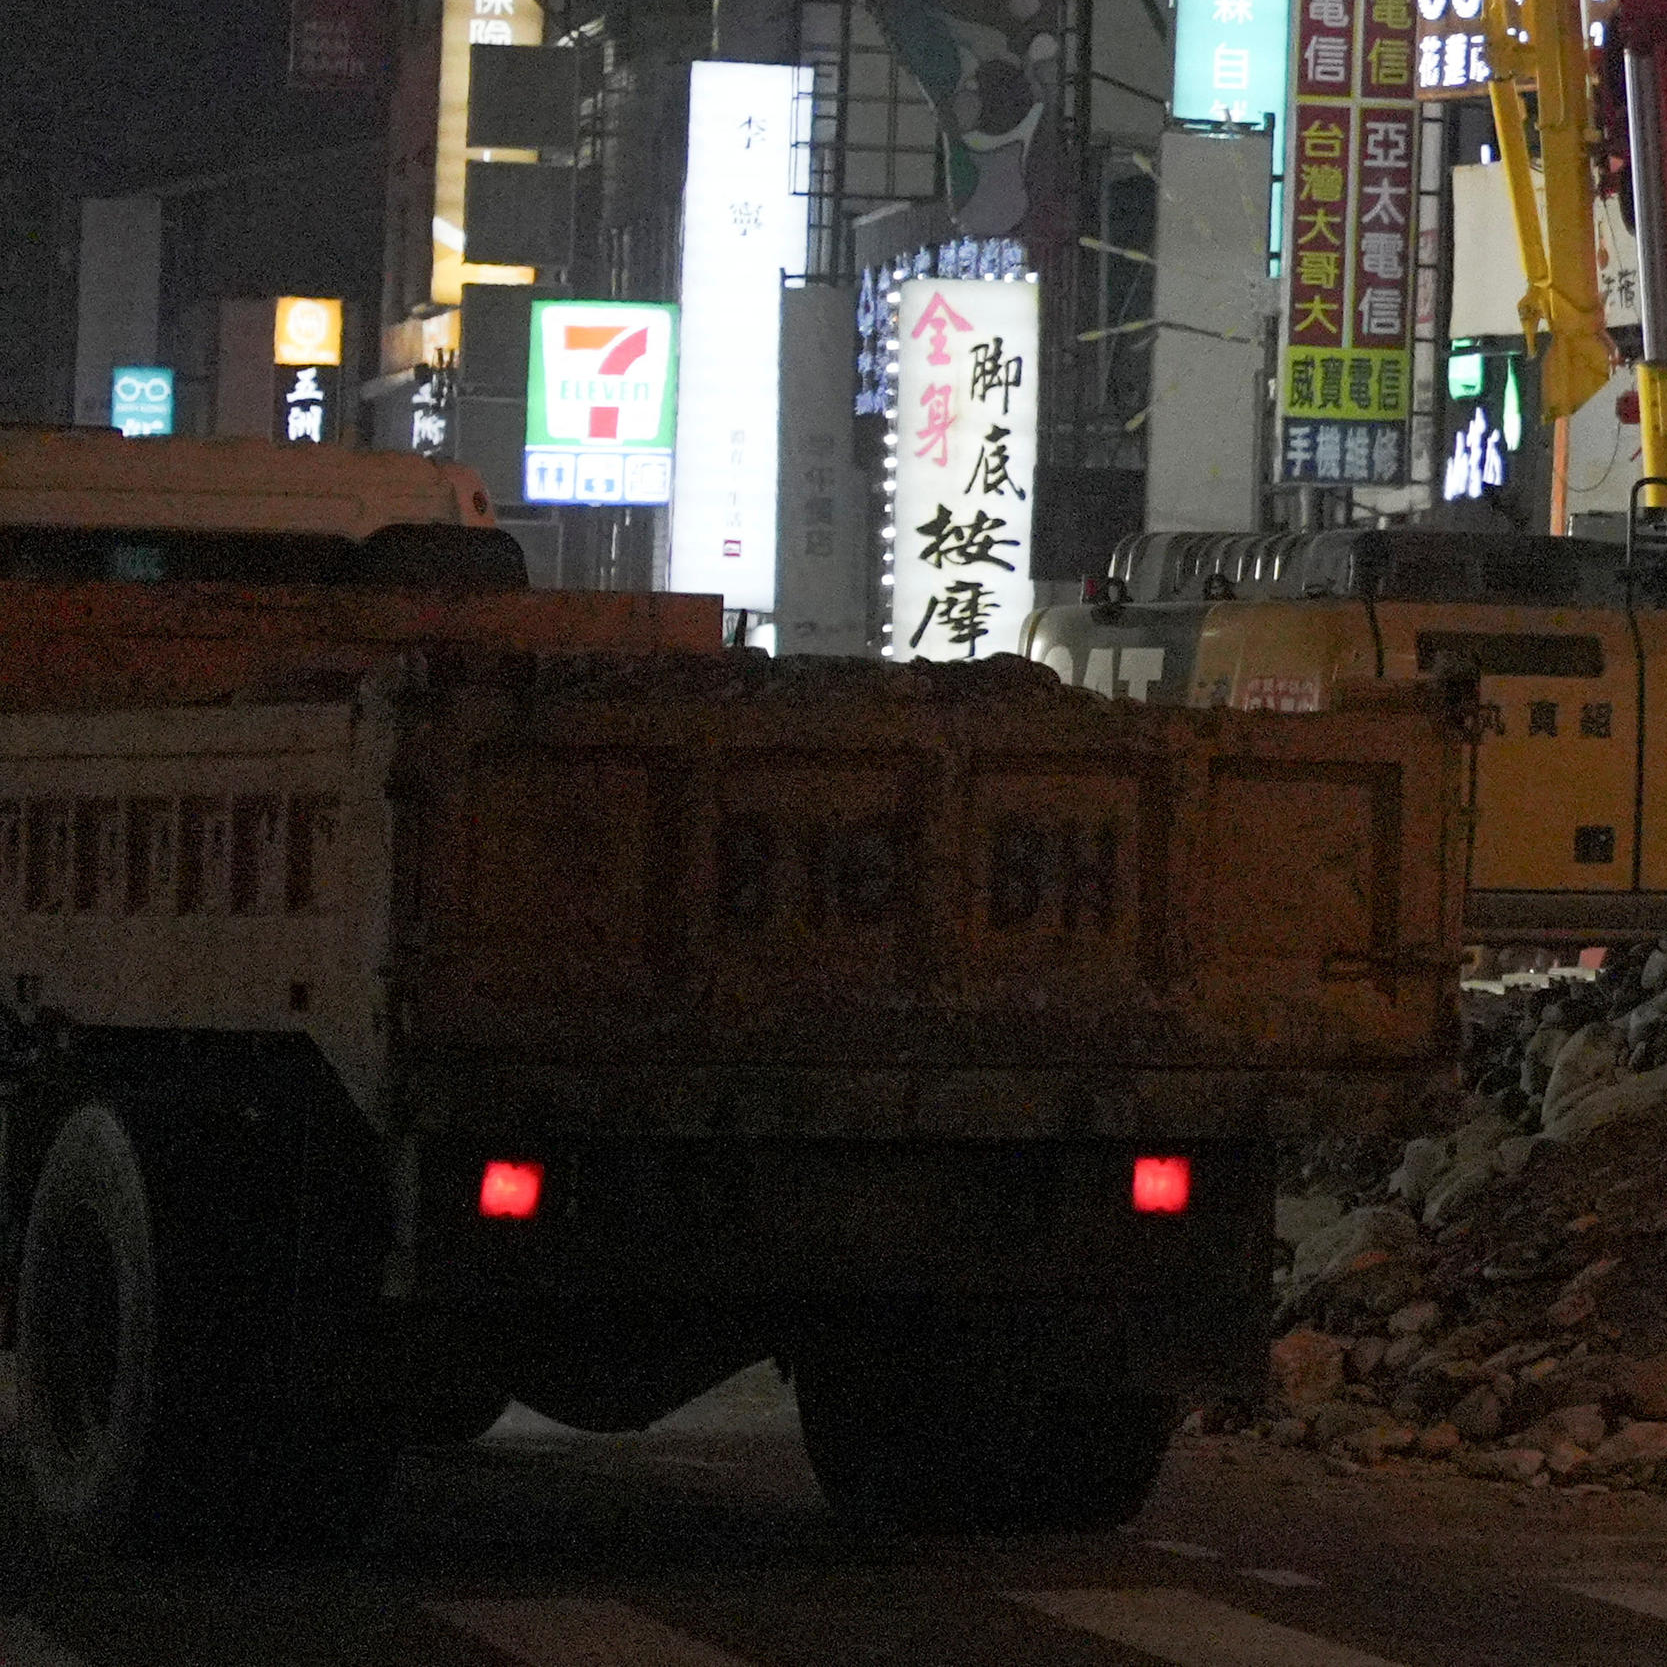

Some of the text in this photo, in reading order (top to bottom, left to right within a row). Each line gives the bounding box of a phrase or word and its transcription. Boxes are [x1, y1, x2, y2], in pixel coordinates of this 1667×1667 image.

[1294, 119, 1345, 335] 台灣大哥大
[1358, 120, 1409, 335] 亞太電信
[911, 291, 975, 469] 全身
[1285, 423, 1402, 482] 手機維修
